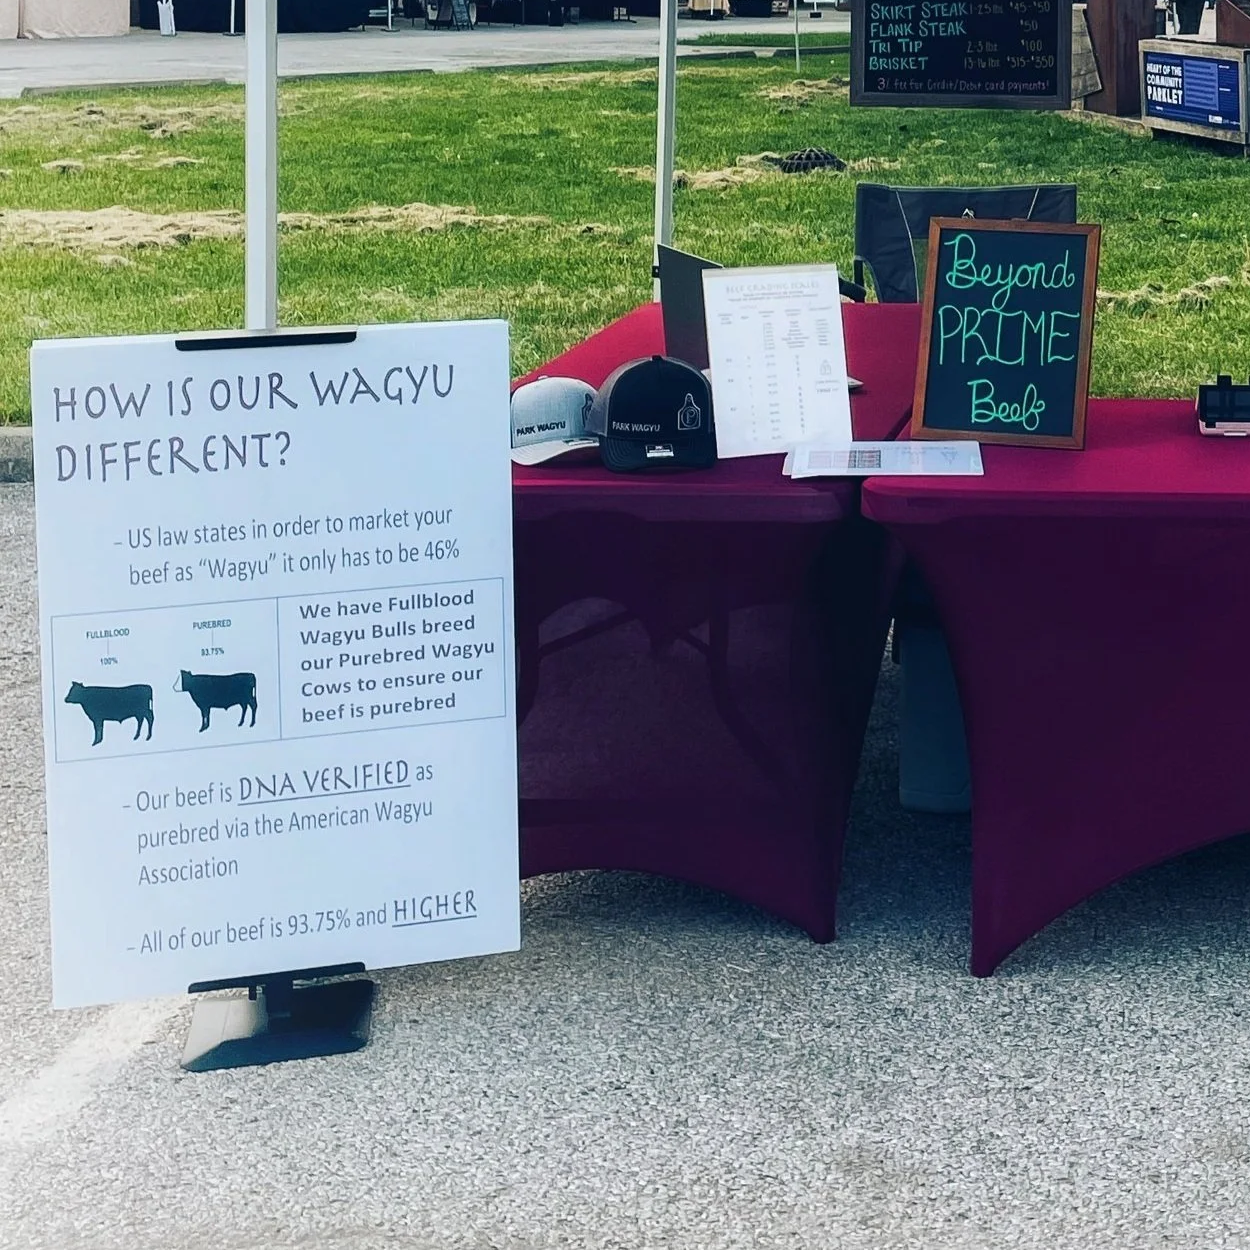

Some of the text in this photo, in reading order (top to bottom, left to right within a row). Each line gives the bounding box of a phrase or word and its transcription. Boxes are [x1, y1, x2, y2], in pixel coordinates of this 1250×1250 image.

[871, 2, 968, 20] SKIRT STEAK
[870, 20, 967, 37] FLANK STEAK
[869, 39, 923, 53] TRI TIP
[869, 57, 928, 70] BRISKET
[1147, 63, 1182, 76] HEART OF THE
[1147, 74, 1182, 88] COMMUNITY
[1147, 86, 1182, 104] PARKLET
[944, 234, 1075, 311] Beyond
[939, 305, 1079, 366] PRIME
[54, 364, 454, 423] HOW IS OUR WAGYU
[967, 379, 1045, 430] Beef
[517, 421, 565, 436] PARK WAGYU
[612, 422, 660, 432] PARK WAGYU
[56, 431, 291, 482] DIFFERENT?
[128, 508, 453, 549] US law states in order to market your
[129, 561, 169, 585] beef
[175, 566, 193, 581] as
[282, 552, 295, 573] it
[300, 546, 336, 572] only
[342, 546, 369, 568] has
[376, 546, 393, 565] to
[399, 542, 419, 564] be
[424, 539, 460, 560] 46%
[300, 590, 474, 620] We have Fullblood
[86, 628, 130, 639] FULLBLOOD
[193, 619, 231, 630] PUREBRED
[300, 615, 475, 648] Wagyu Bulls breed
[301, 640, 495, 672] our Purebred Wagyu
[302, 666, 483, 697] Cows to ensure our
[302, 693, 456, 724] beef is purebred
[137, 760, 433, 812] Our beef is DNA VERIFIED as
[138, 800, 432, 853] purebred via the American Wagyu
[138, 856, 238, 886] Association
[140, 890, 476, 954] All of our beef is 93.75% and HIGHER
